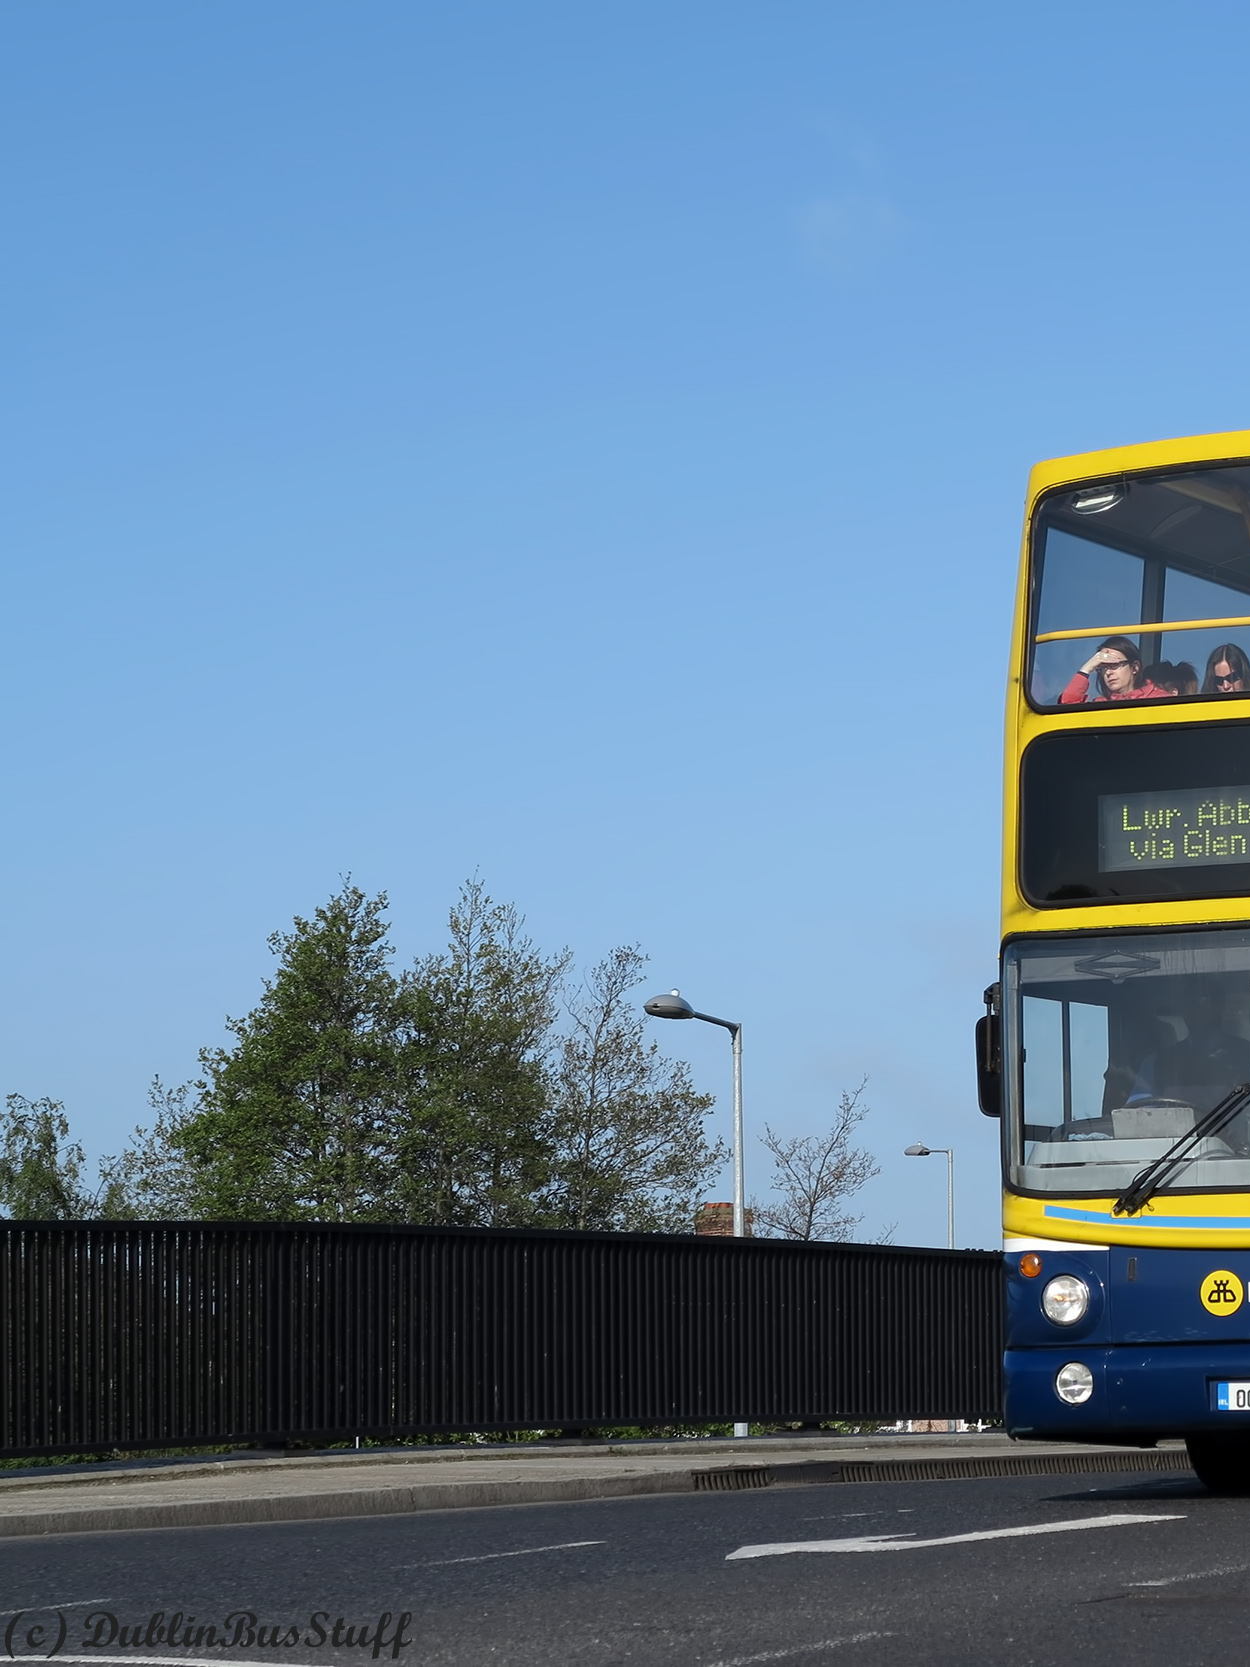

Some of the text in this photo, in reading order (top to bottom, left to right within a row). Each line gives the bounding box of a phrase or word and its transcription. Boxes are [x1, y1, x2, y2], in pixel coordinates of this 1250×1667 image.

[1123, 805, 1189, 831] Lwr.
[1130, 832, 1174, 860] via
[1184, 829, 1247, 858] Glen
